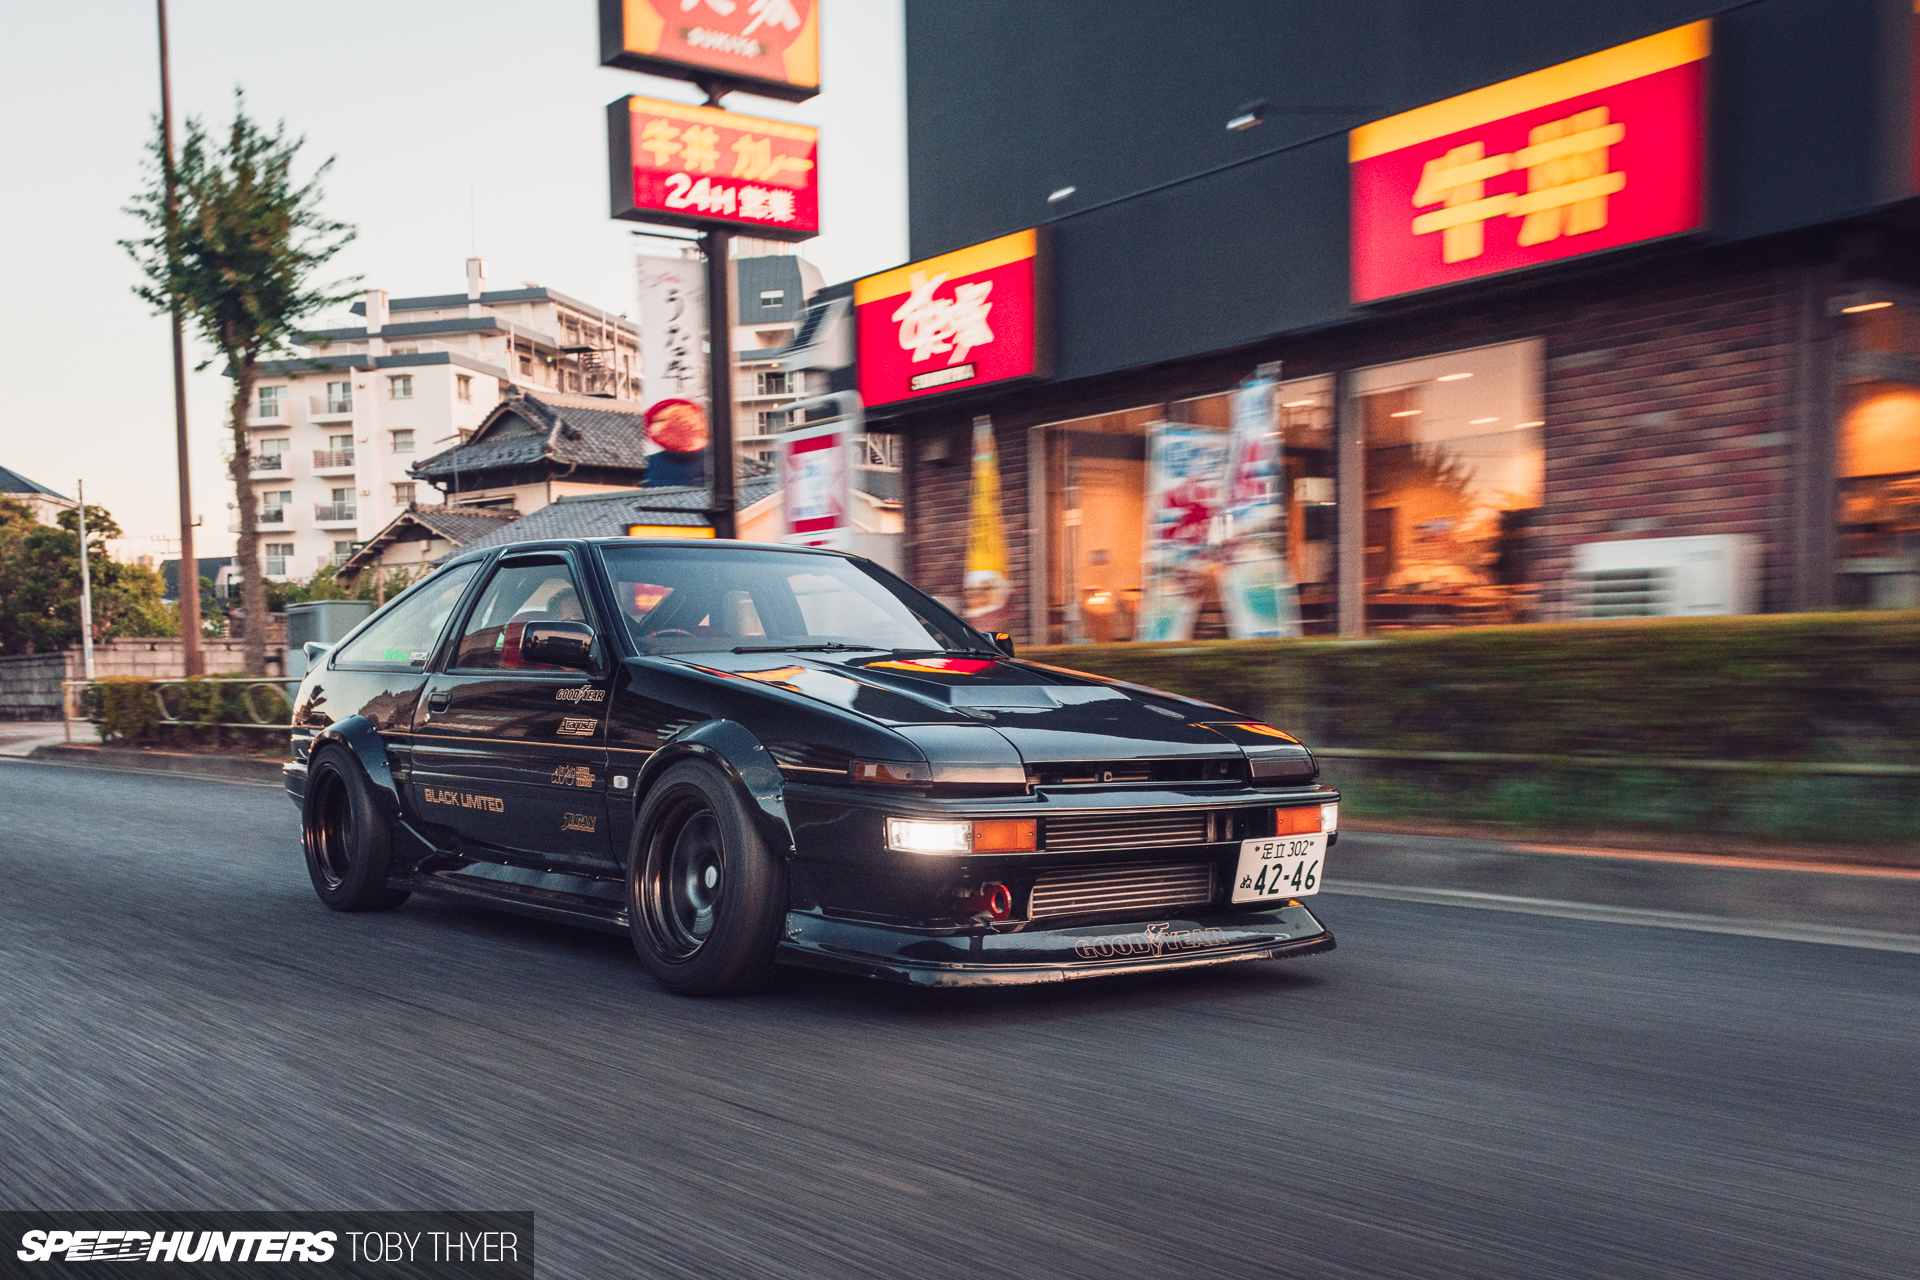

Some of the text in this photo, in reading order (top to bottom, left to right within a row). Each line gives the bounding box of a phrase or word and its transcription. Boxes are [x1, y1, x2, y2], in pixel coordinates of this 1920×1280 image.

[731, 133, 814, 181] カレー
[1412, 105, 1626, 264] 牛丼
[556, 685, 605, 704] GOODYEAR
[424, 788, 504, 813] BLACK LIMITED
[1261, 840, 1309, 859] 足立 302
[1254, 860, 1319, 895] 42-46
[1075, 922, 1229, 957] GOODYEAR
